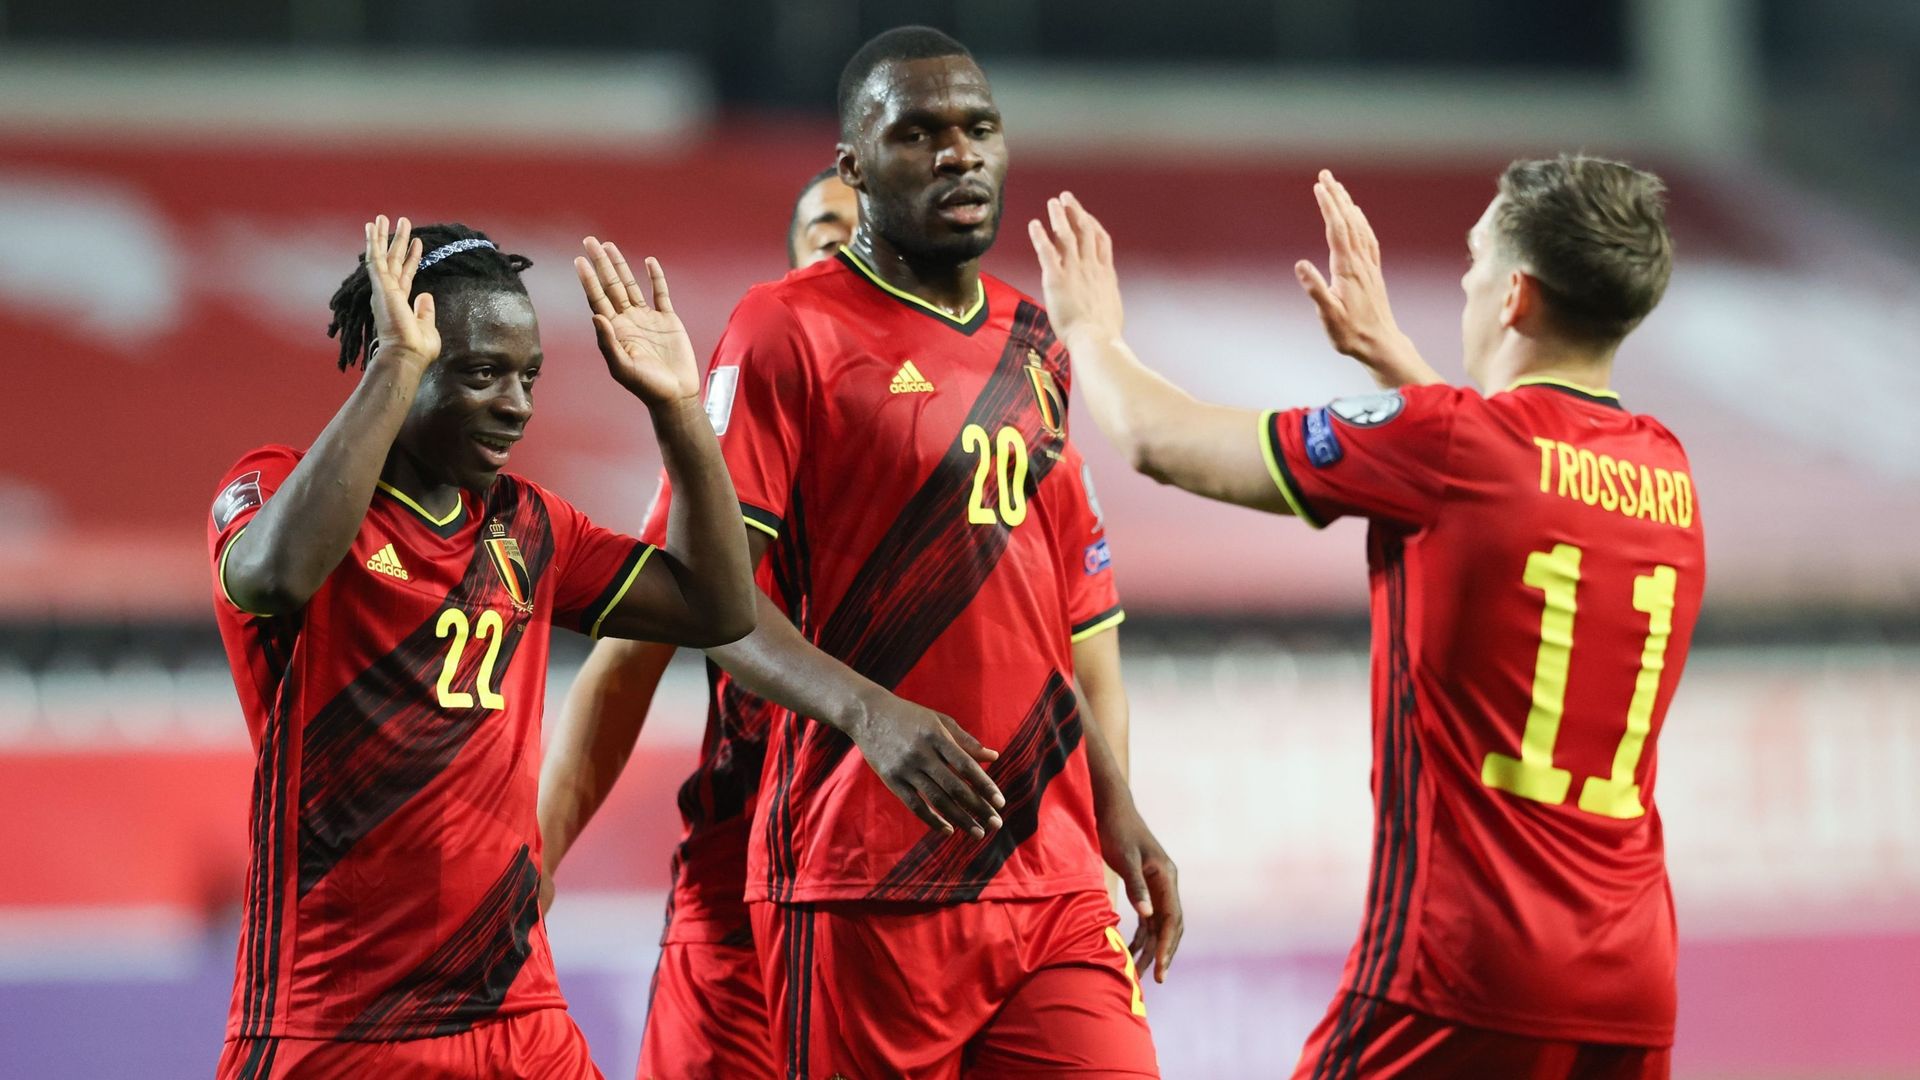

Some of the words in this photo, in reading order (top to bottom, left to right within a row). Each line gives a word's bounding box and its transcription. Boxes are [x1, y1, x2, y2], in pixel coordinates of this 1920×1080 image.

[889, 381, 935, 394] adidas
[961, 424, 1029, 527] 20
[1533, 436, 1693, 529] TROSSARD
[366, 559, 409, 580] adidas
[435, 607, 505, 711] 22
[1481, 543, 1677, 819] 11
